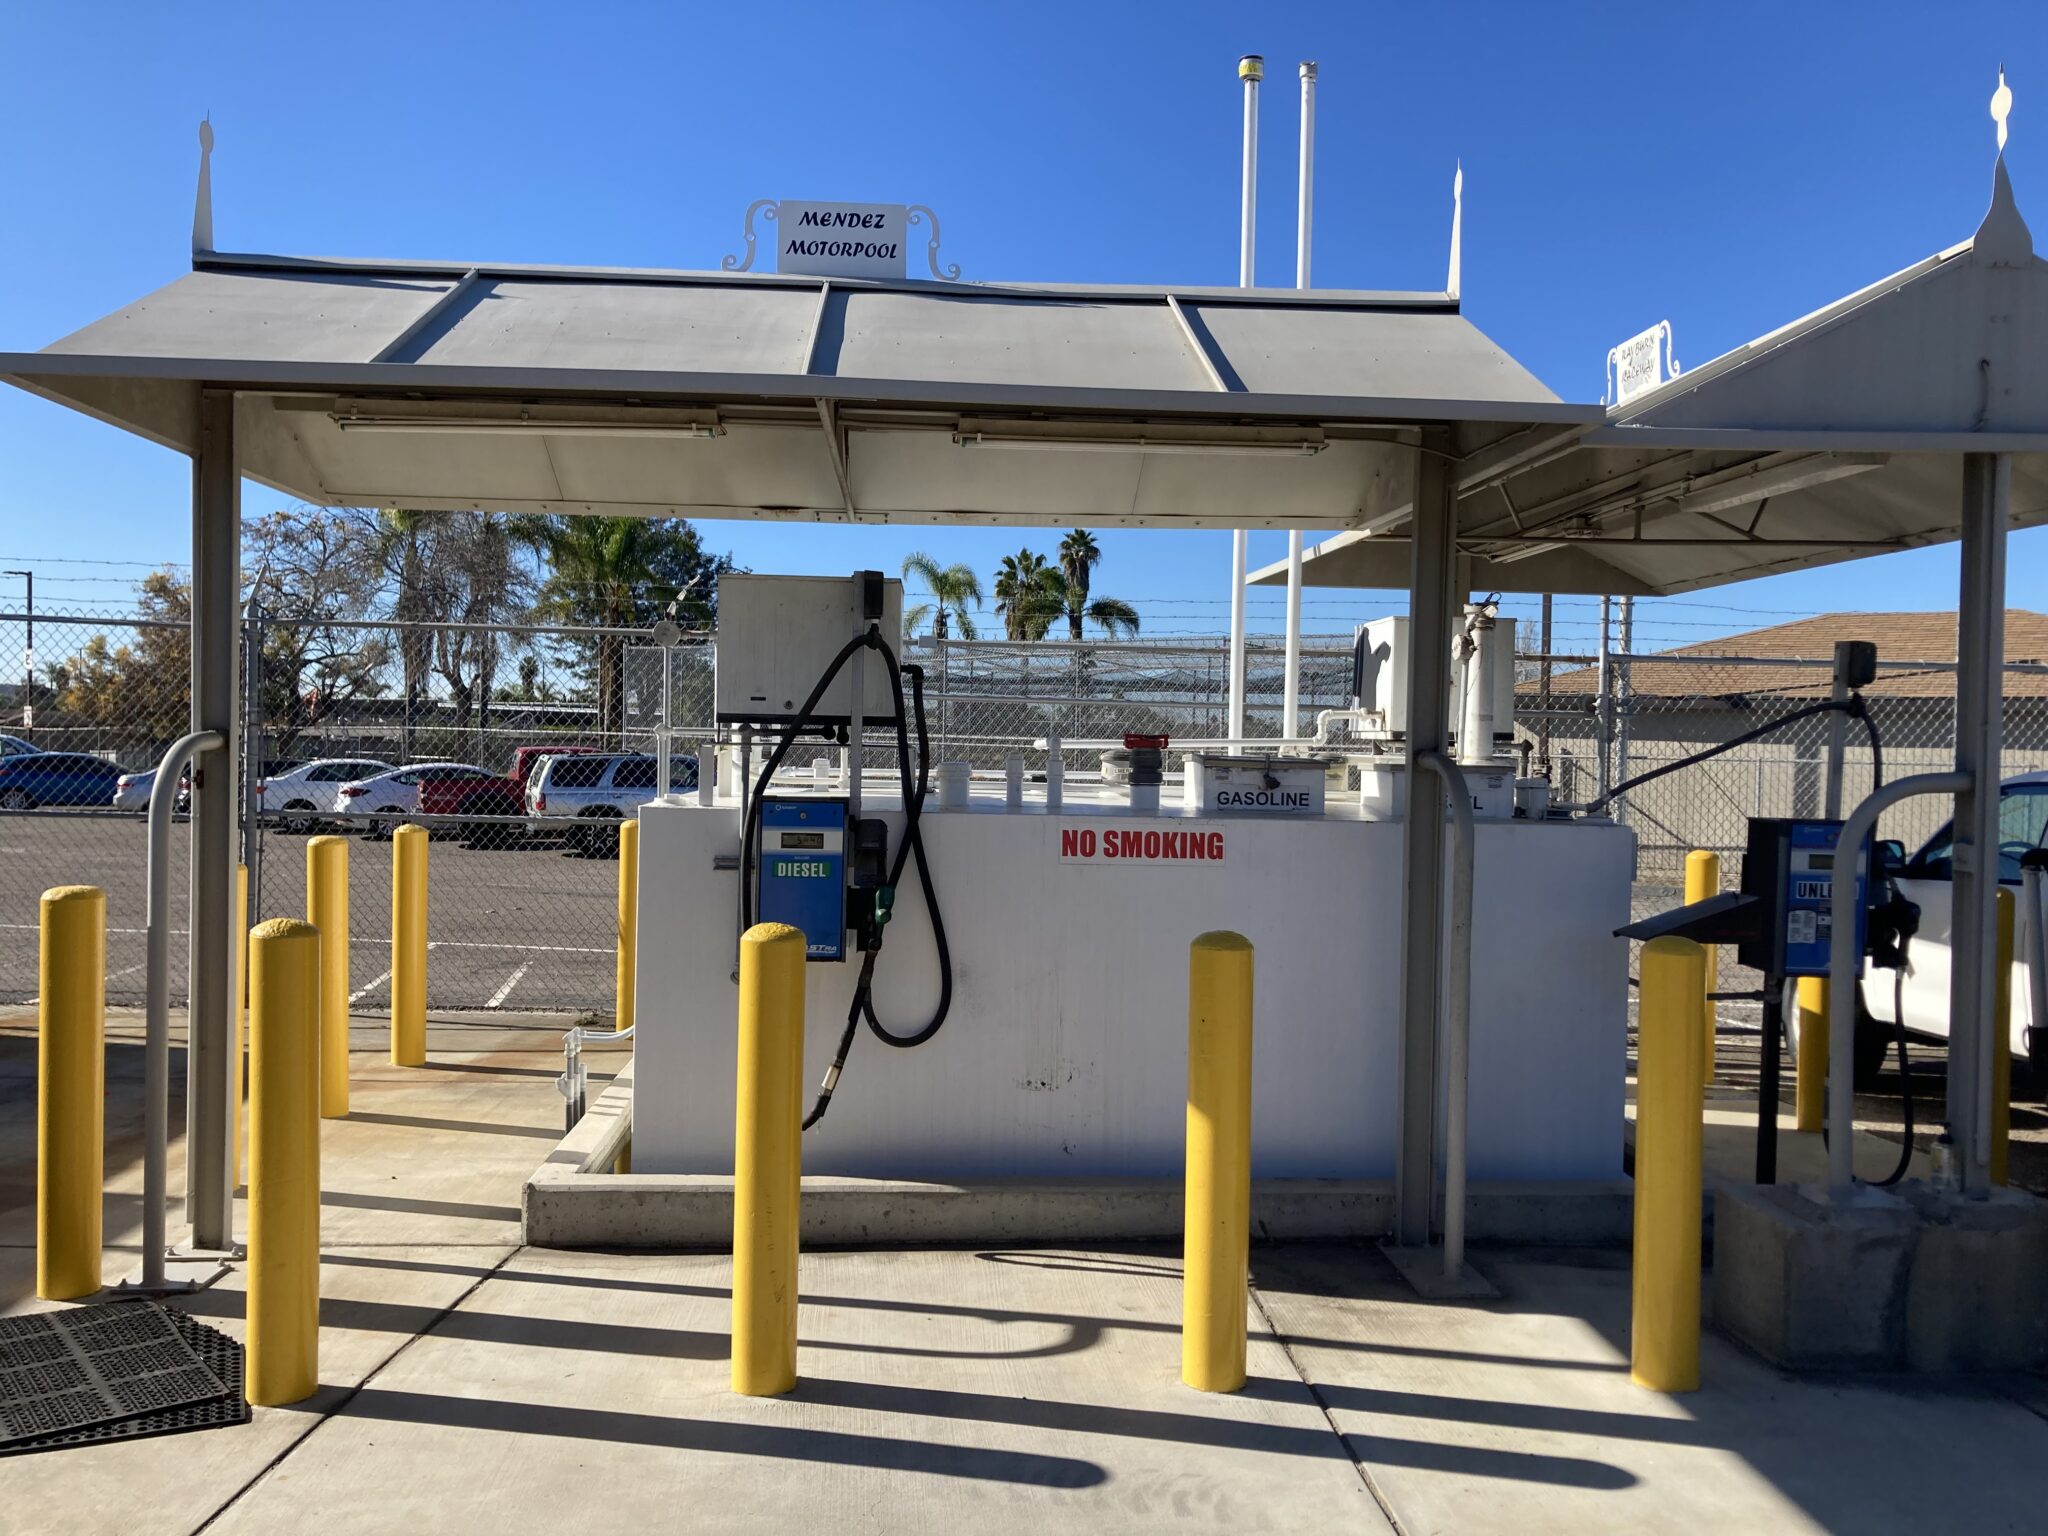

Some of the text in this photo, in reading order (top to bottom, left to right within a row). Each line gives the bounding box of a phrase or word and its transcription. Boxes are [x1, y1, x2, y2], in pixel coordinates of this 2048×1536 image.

[798, 211, 886, 229] MENDEZ
[785, 239, 897, 259] MOTORPOOL
[1217, 791, 1310, 807] GASOLINE
[1061, 829, 1224, 860] NO SMOKING
[777, 862, 827, 878] DIESEL
[1798, 882, 1833, 898] UNLE
[806, 944, 838, 953] STRA
